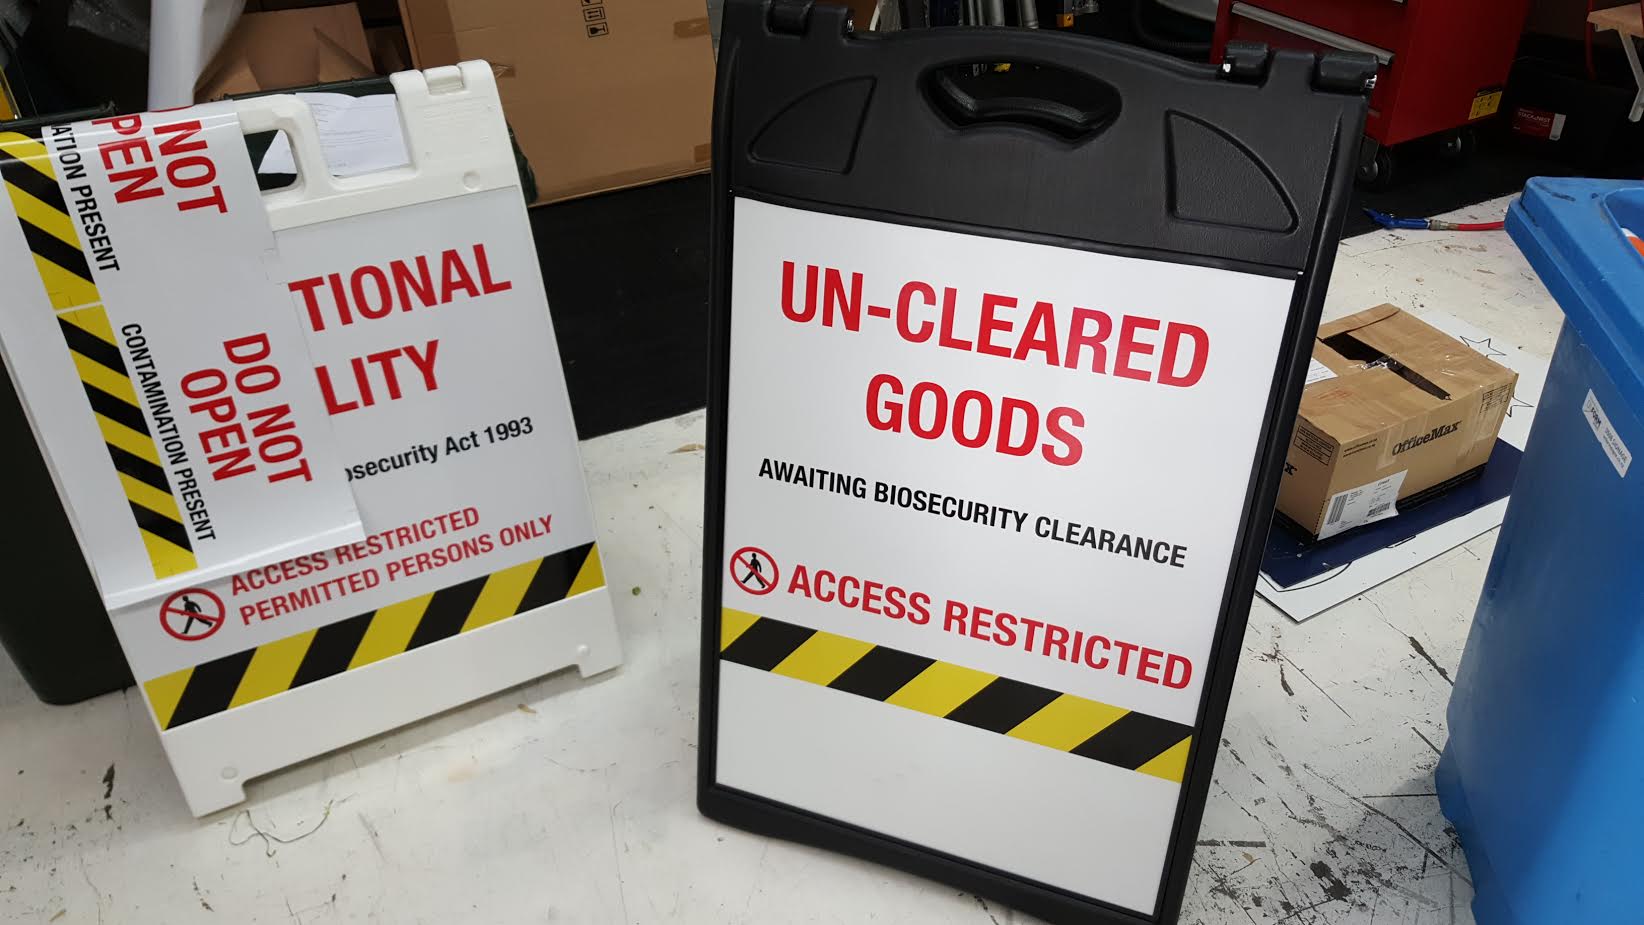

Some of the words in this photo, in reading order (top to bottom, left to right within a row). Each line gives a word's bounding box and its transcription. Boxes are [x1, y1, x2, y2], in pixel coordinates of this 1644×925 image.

[153, 120, 228, 214] NOT
[70, 185, 121, 272] PRESENT
[223, 333, 281, 395] DO
[781, 260, 1210, 388] UN-CLEARED
[121, 323, 189, 466] CONTAMINATION
[173, 467, 216, 541] PRESENT
[180, 368, 257, 481] OPEN
[247, 404, 313, 484] NOT
[445, 431, 481, 455] Act
[484, 416, 534, 444] 1993
[866, 374, 1086, 467] GOODS
[1392, 420, 1462, 456] OfficeMax
[231, 551, 329, 597] ACCESS
[334, 507, 480, 565] RESTRICTED
[759, 458, 867, 499] AWAITING
[875, 482, 1029, 533] BIOSECURITY
[1036, 516, 1188, 568] CLEARANCE
[239, 568, 380, 627] PERMITTED
[387, 534, 495, 582] PERSONS
[499, 515, 553, 546] ONLY
[787, 563, 932, 626] ACCESS
[943, 599, 1194, 690] RESTRICTED
